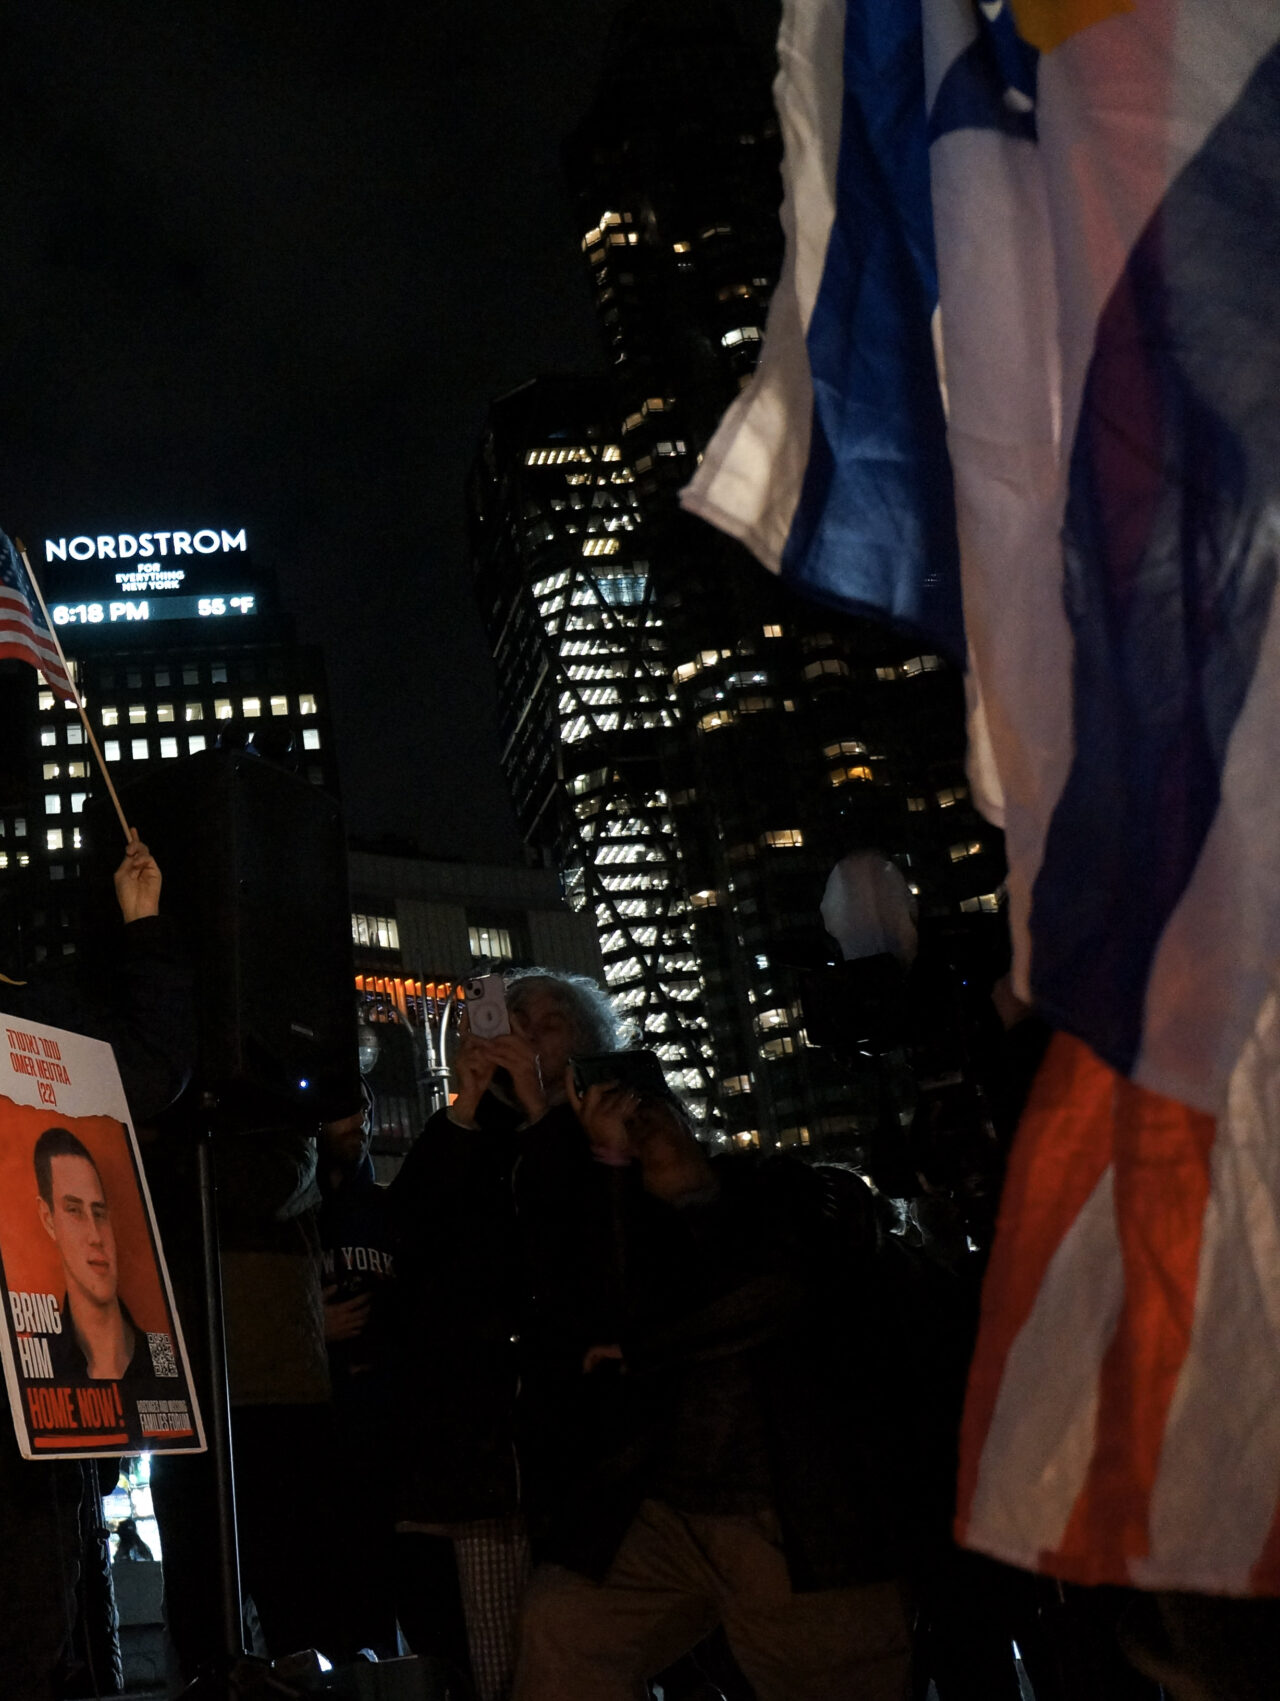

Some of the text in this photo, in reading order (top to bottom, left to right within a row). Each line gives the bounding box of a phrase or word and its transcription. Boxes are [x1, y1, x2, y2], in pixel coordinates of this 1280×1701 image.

[45, 529, 247, 562] NORDSTROM
[115, 570, 185, 583] EVERYTHING
[138, 562, 161, 573] FOR
[122, 580, 180, 592] NEW YORK
[53, 604, 104, 625] 6:18
[110, 601, 149, 621] PM
[198, 598, 226, 616] 55
[10, 1052, 71, 1085] OMER NEUTRA
[37, 1080, 57, 1106] (22)
[341, 1246, 396, 1278] YORK
[8, 1291, 63, 1334] BRING
[17, 1337, 54, 1379] HIM
[27, 1383, 125, 1429] HOME NOW!
